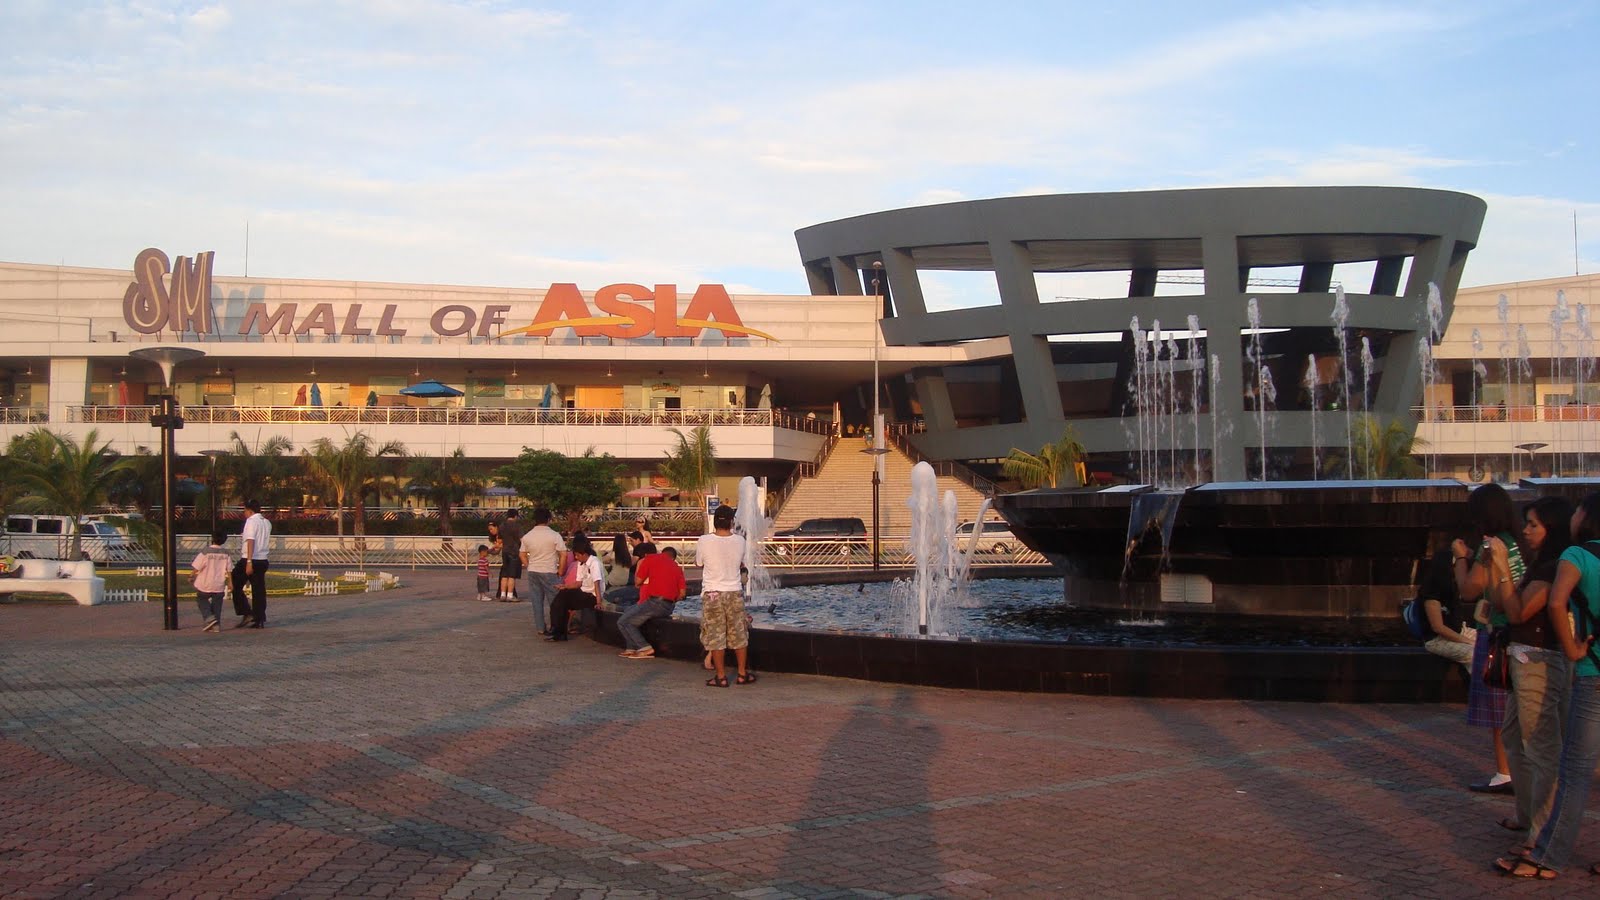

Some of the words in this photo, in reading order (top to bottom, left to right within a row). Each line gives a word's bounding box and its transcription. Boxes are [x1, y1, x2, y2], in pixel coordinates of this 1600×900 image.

[123, 247, 215, 334] SM
[238, 303, 406, 336] MALL
[430, 304, 511, 336] OF
[526, 283, 747, 339] ASIA
